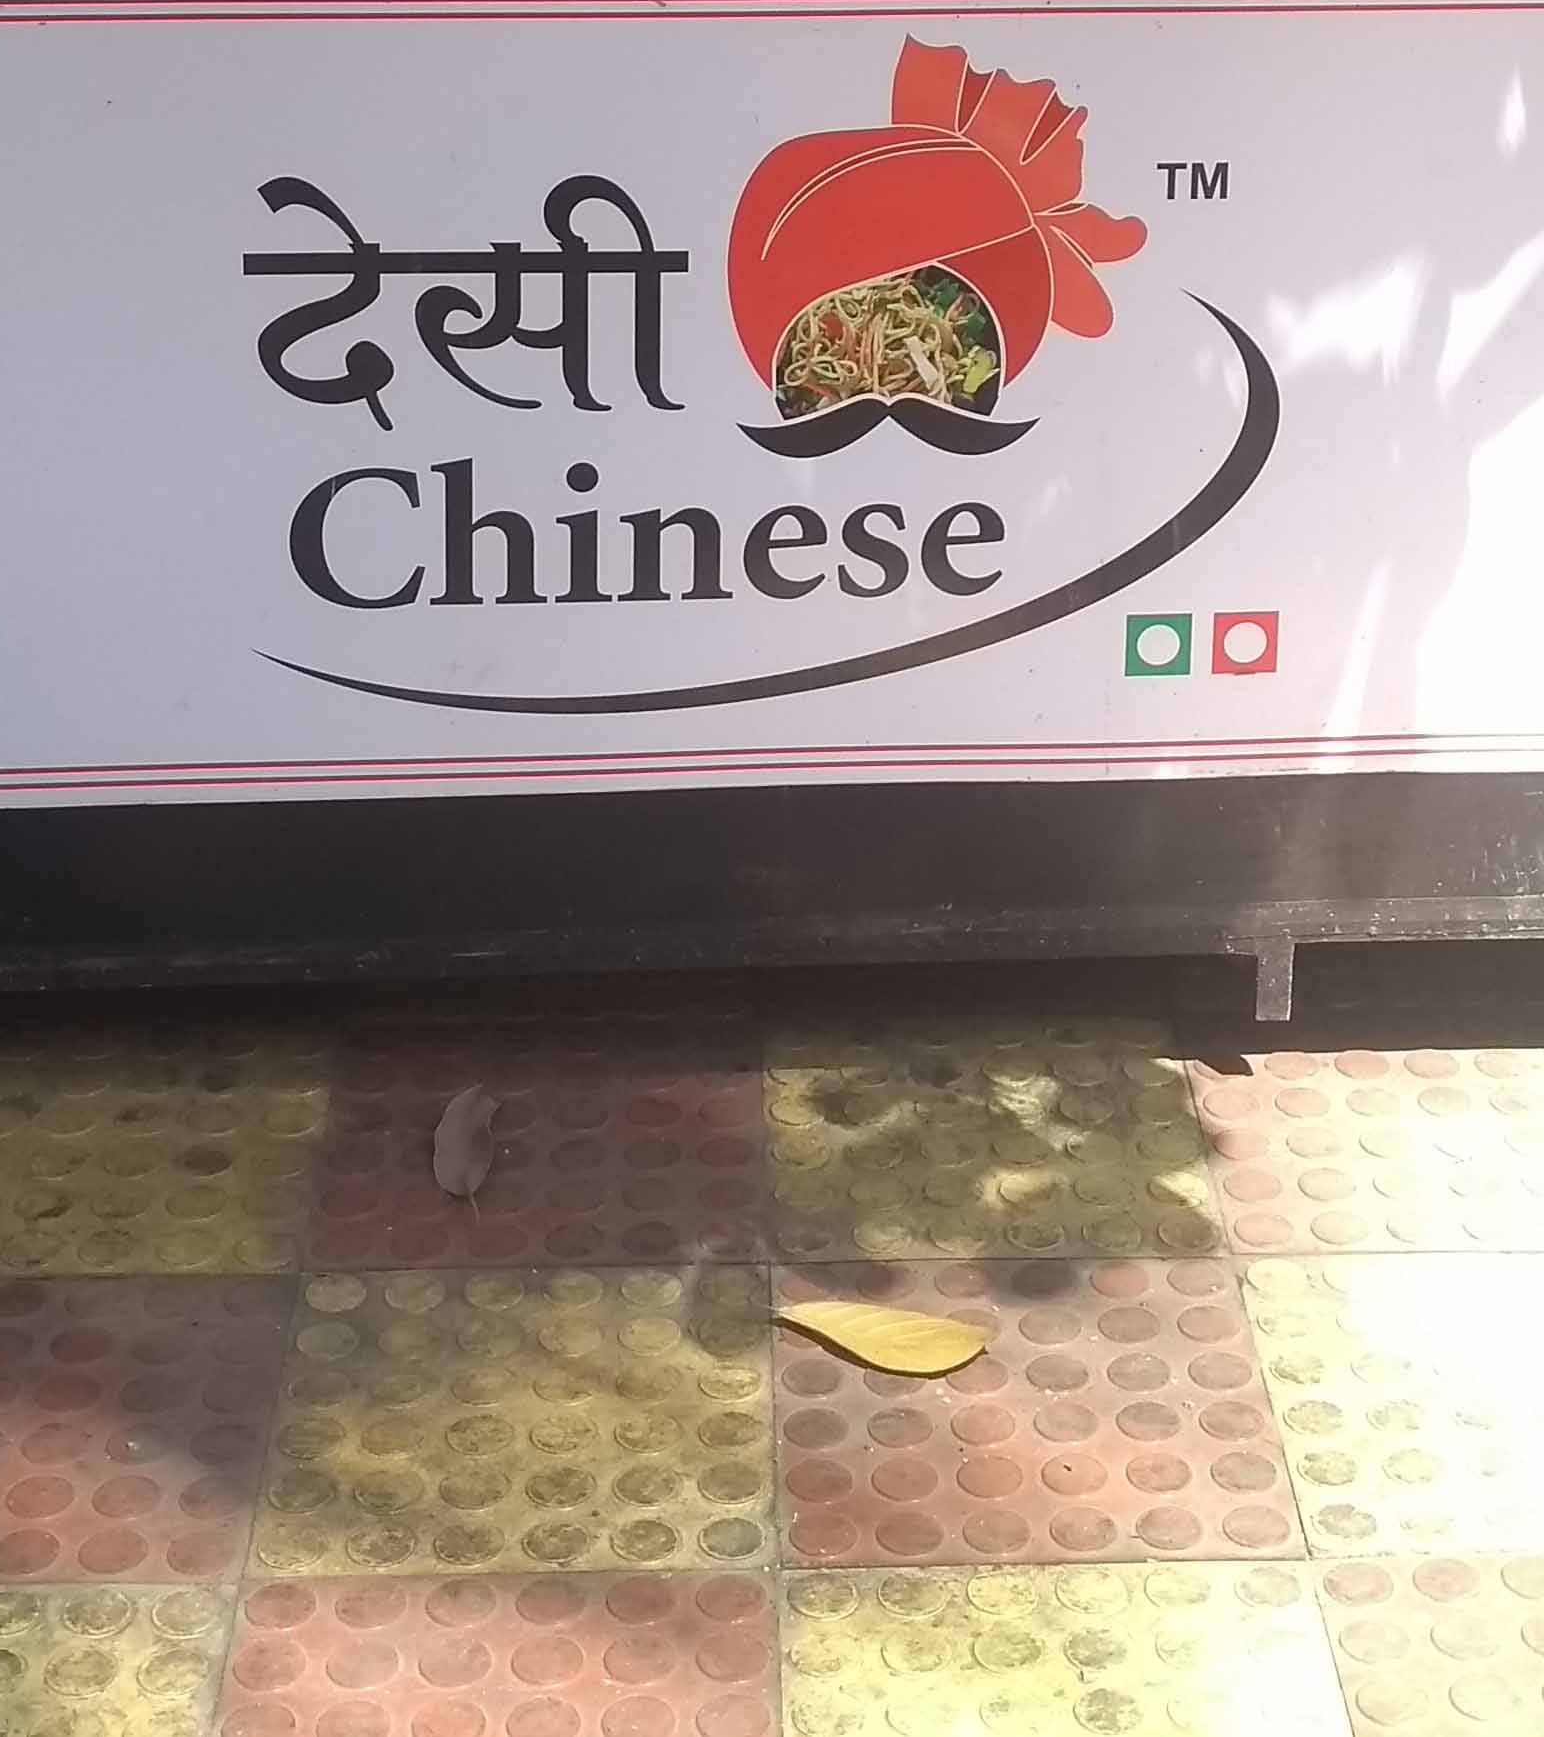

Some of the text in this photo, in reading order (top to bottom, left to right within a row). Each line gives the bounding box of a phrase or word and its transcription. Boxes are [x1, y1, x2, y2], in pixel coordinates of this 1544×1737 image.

[1156, 162, 1229, 200] TM
[243, 175, 689, 431] देसी
[289, 457, 1005, 609] Chinese
